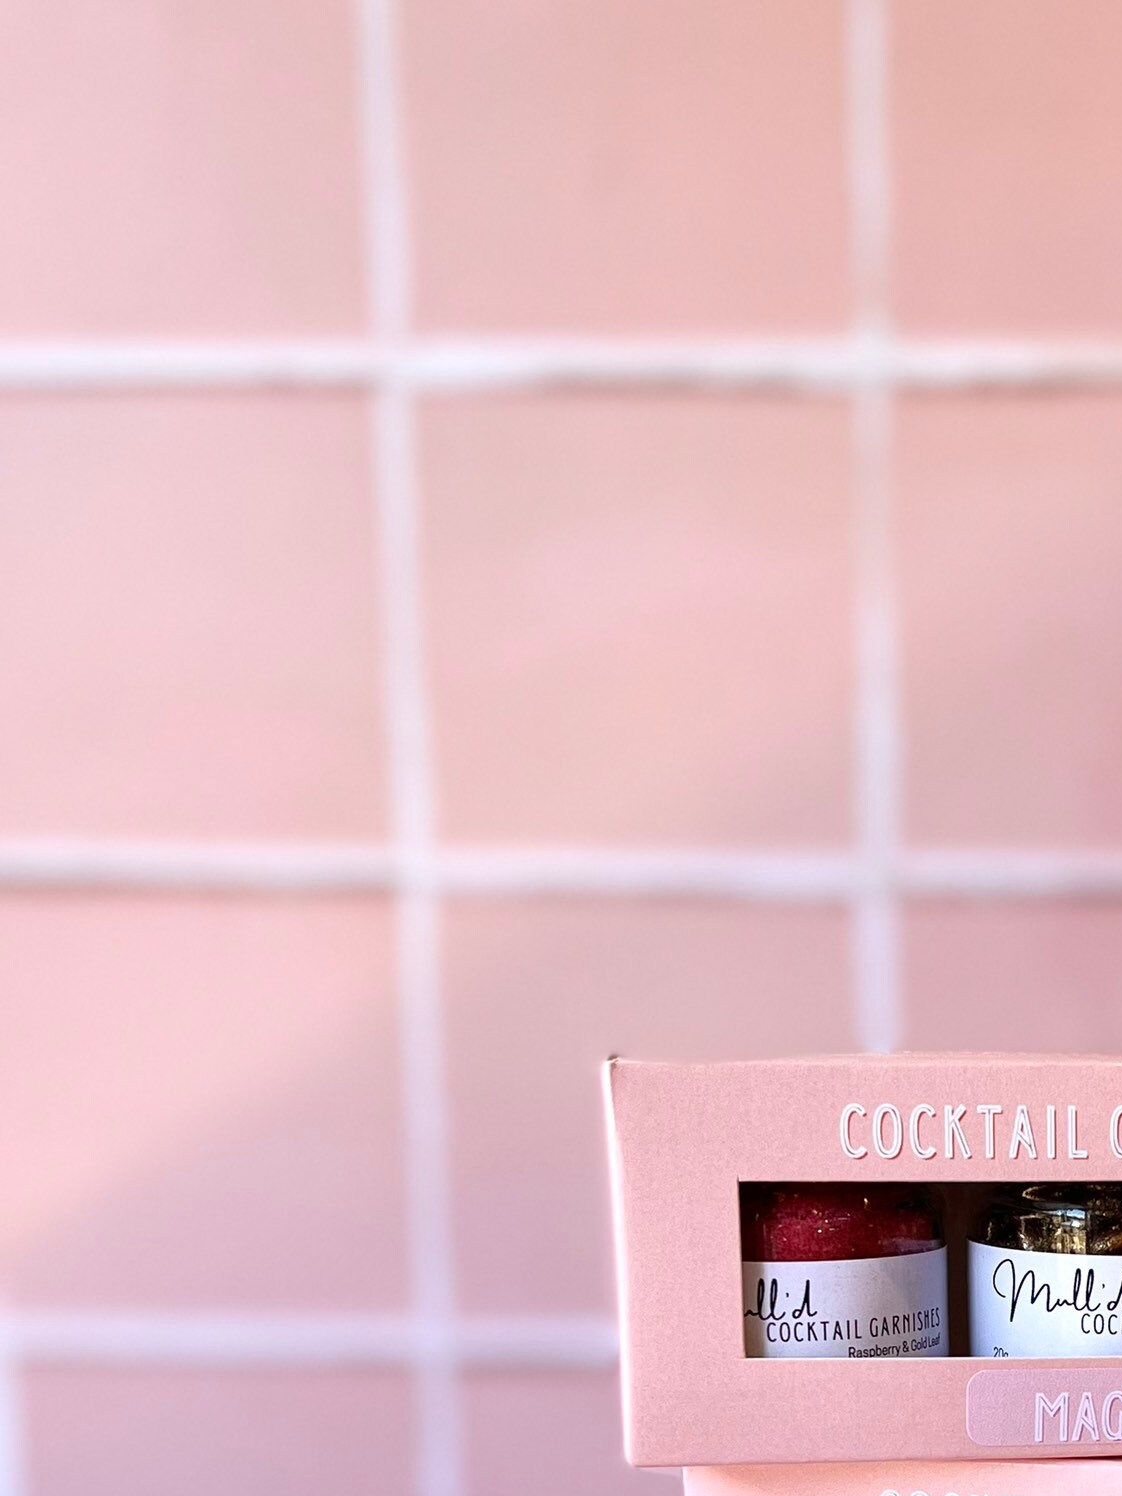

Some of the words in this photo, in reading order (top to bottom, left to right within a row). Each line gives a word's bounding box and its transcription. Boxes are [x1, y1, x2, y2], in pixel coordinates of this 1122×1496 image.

[839, 1103, 1090, 1159] COCKTAIL
[766, 1319, 862, 1342] COCKTAIL
[869, 1307, 941, 1338] GARNISHES
[848, 1343, 901, 1358] Raspberry
[902, 1341, 910, 1353] &
[911, 1337, 928, 1351] Gold
[928, 1333, 941, 1346] Leaf
